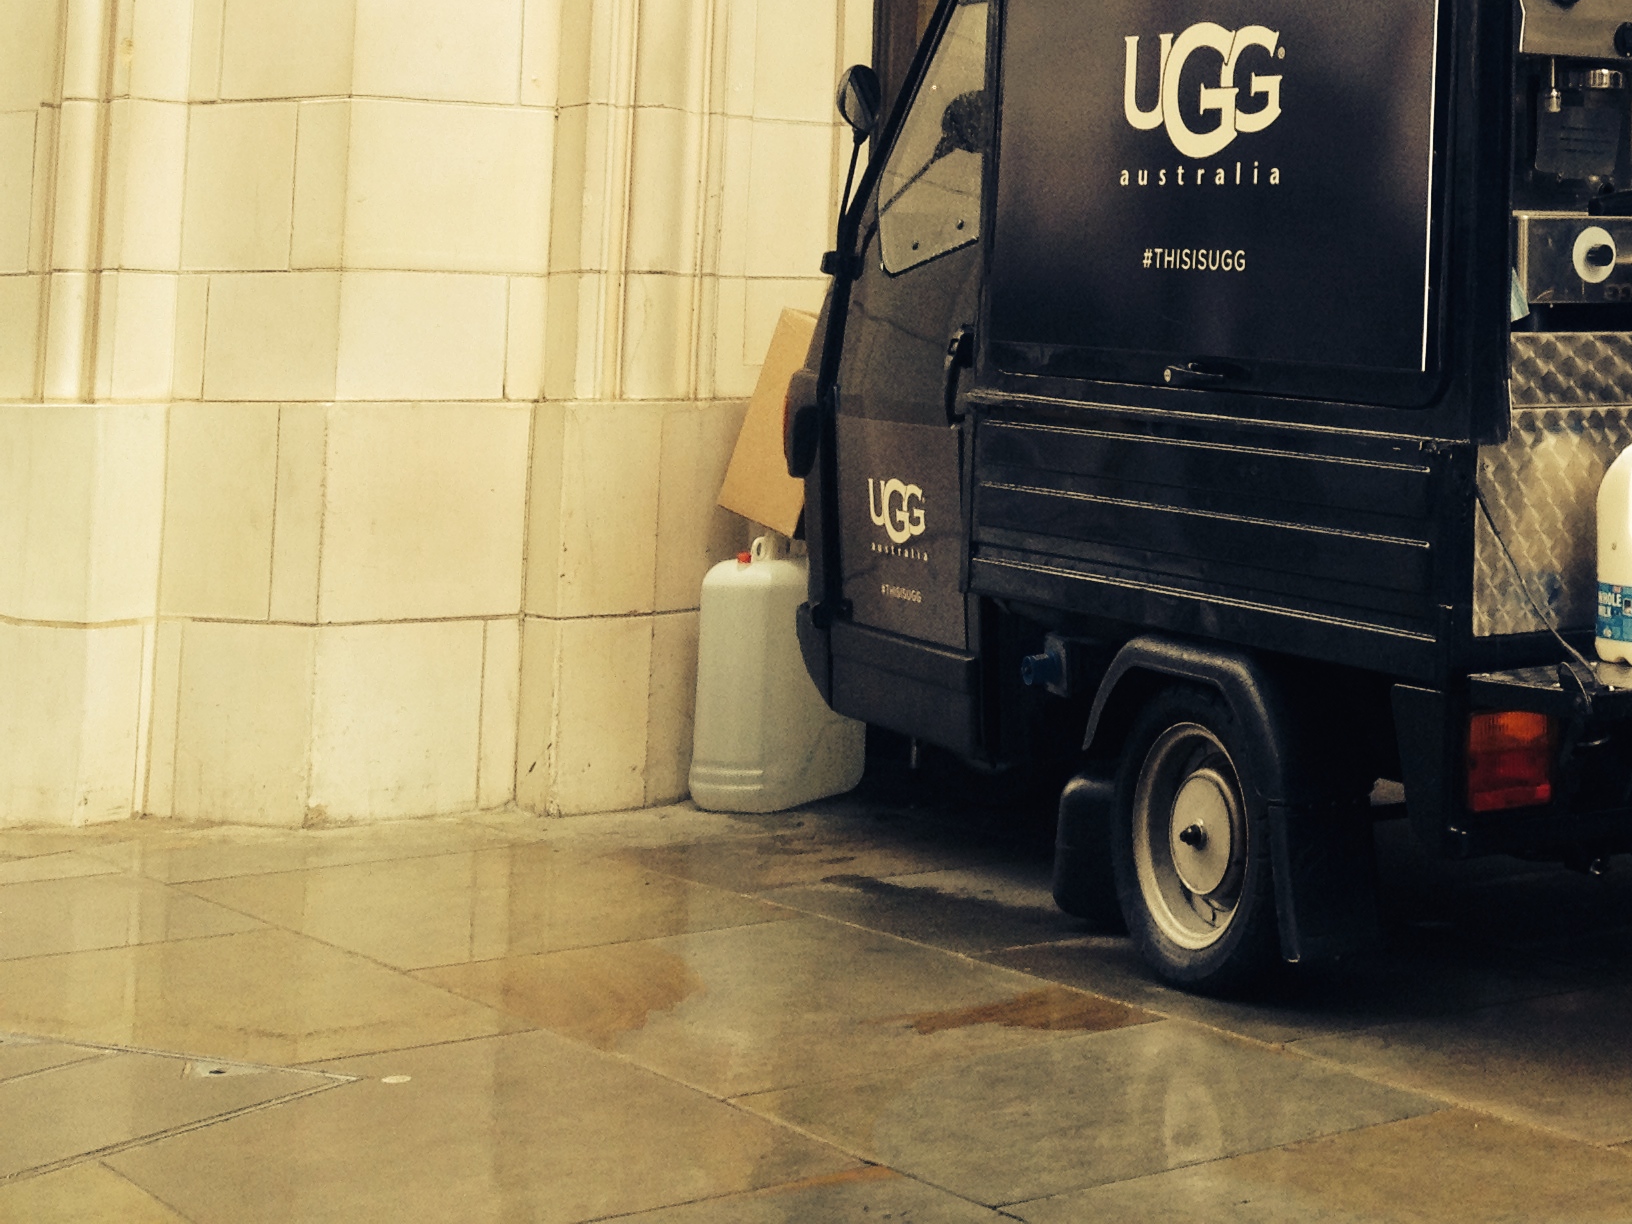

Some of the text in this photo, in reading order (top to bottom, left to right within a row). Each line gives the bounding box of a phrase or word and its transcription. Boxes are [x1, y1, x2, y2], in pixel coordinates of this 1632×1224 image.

[1124, 21, 1283, 159] UGG
[1119, 161, 1281, 186] australia
[1142, 248, 1247, 273] #THISISUGG
[868, 477, 926, 544] UGG
[870, 541, 929, 562] australia
